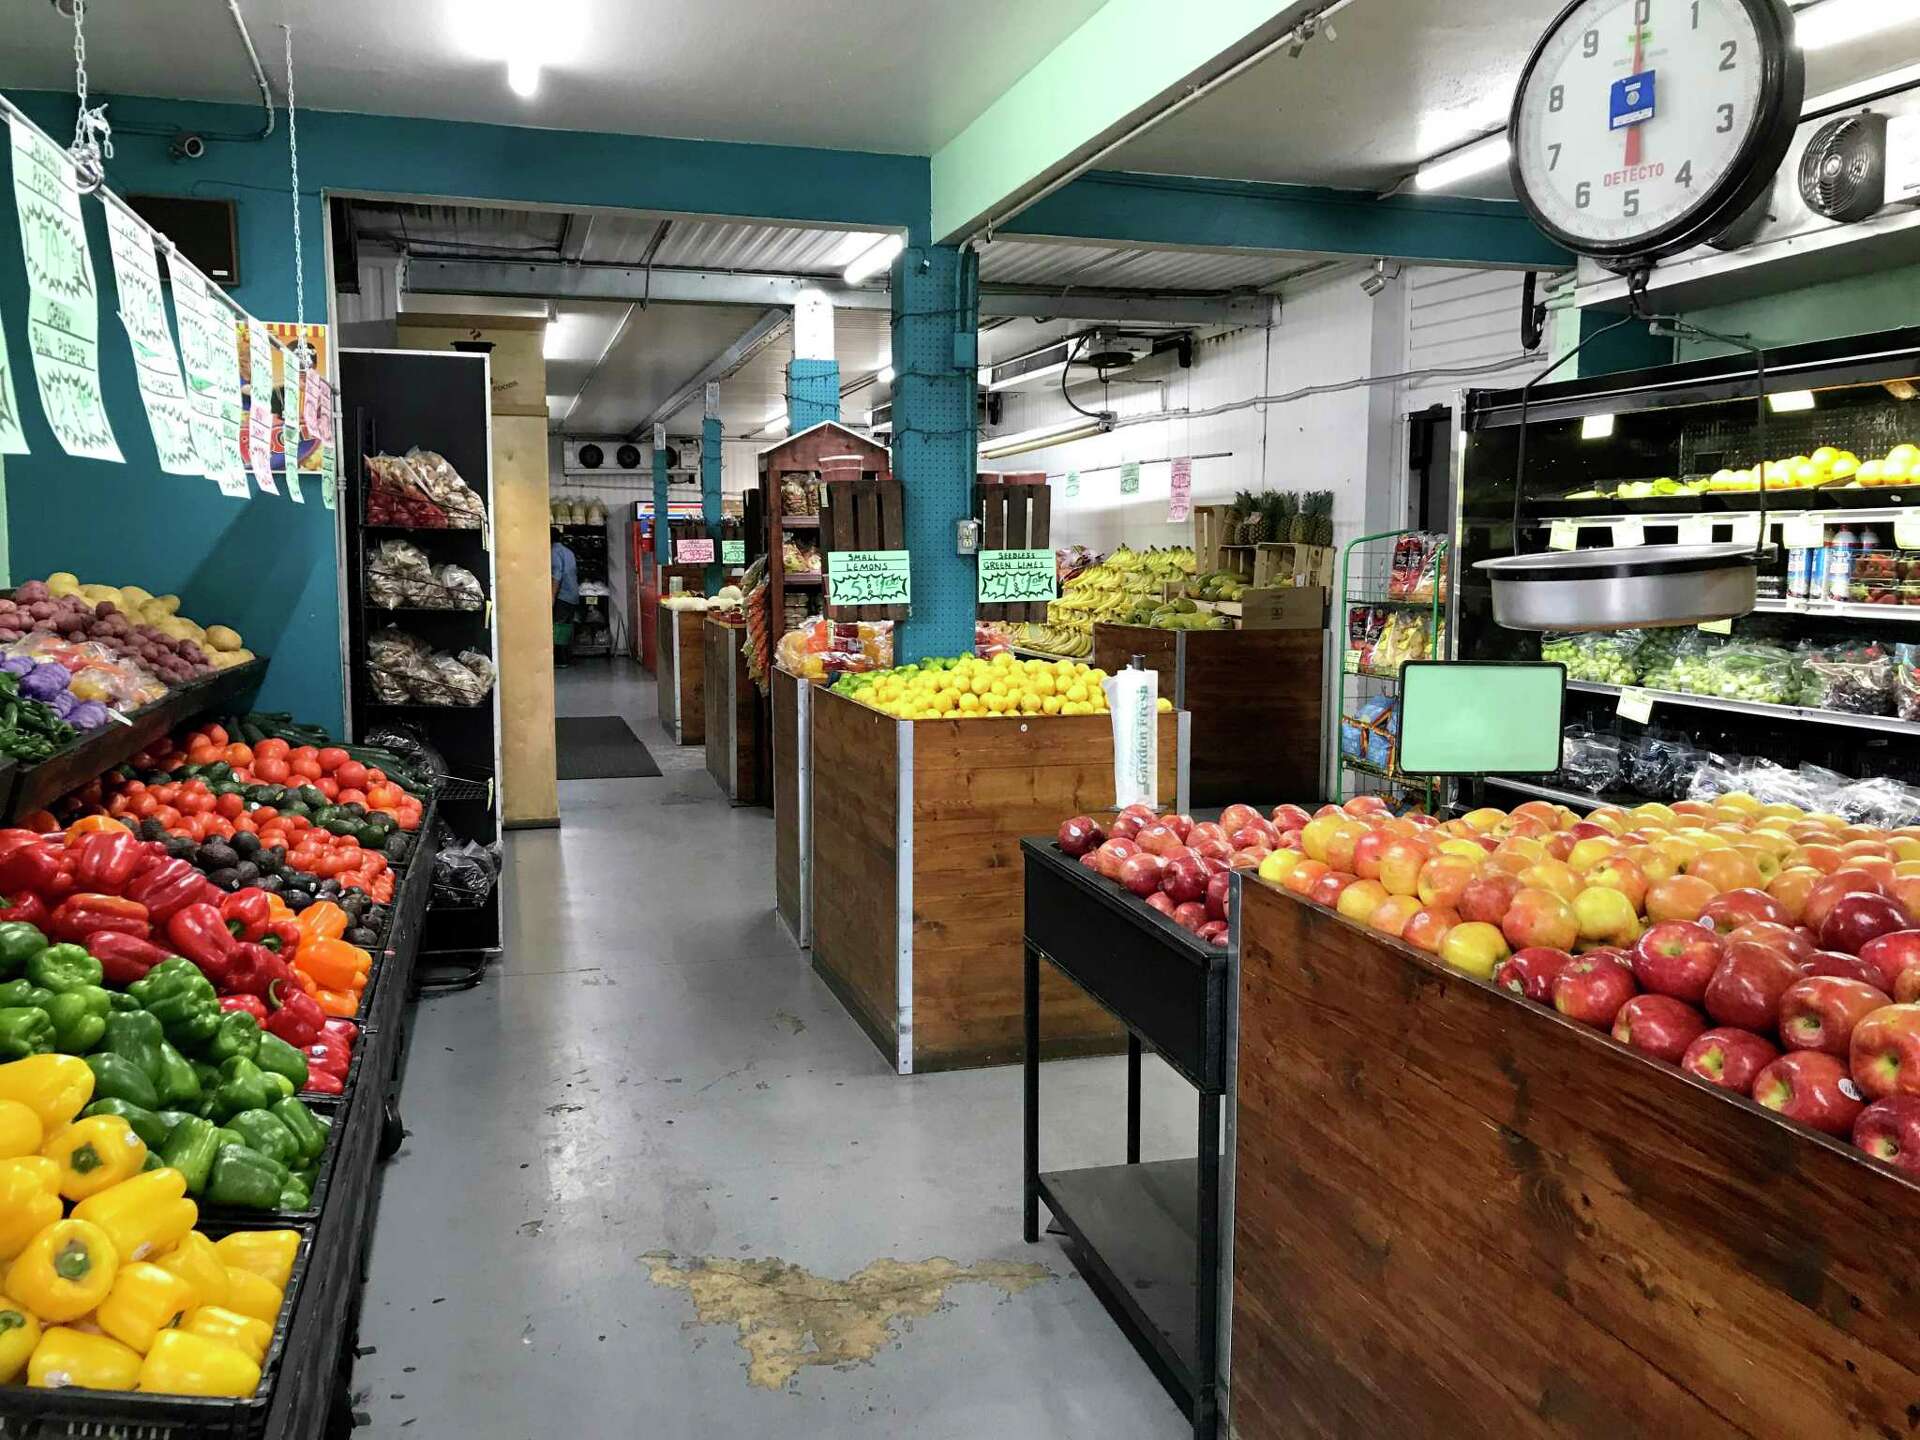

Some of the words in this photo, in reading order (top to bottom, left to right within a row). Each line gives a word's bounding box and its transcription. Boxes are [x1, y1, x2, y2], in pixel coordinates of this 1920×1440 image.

[1634, 0, 1650, 26] 0
[1691, 1, 1700, 29] 1
[1583, 30, 1599, 58] 9
[1719, 40, 1737, 71] 2
[1549, 85, 1564, 112] 8
[1716, 103, 1734, 133] 3
[1547, 143, 1562, 171] 7
[1603, 163, 1664, 187] DETECTO
[1675, 160, 1692, 188] 4
[1575, 182, 1590, 208] 6
[1623, 189, 1640, 217] 5
[846, 563, 888, 571] LEMONS
[848, 553, 879, 561] SMALL
[983, 561, 1011, 570] GREEN
[1017, 561, 1044, 569] LIMES
[998, 552, 1035, 560] SEEDLESS
[851, 580, 863, 596] 5
[996, 577, 1009, 596] 4
[1136, 685, 1149, 727] Fresh
[1136, 730, 1149, 786] Garden
